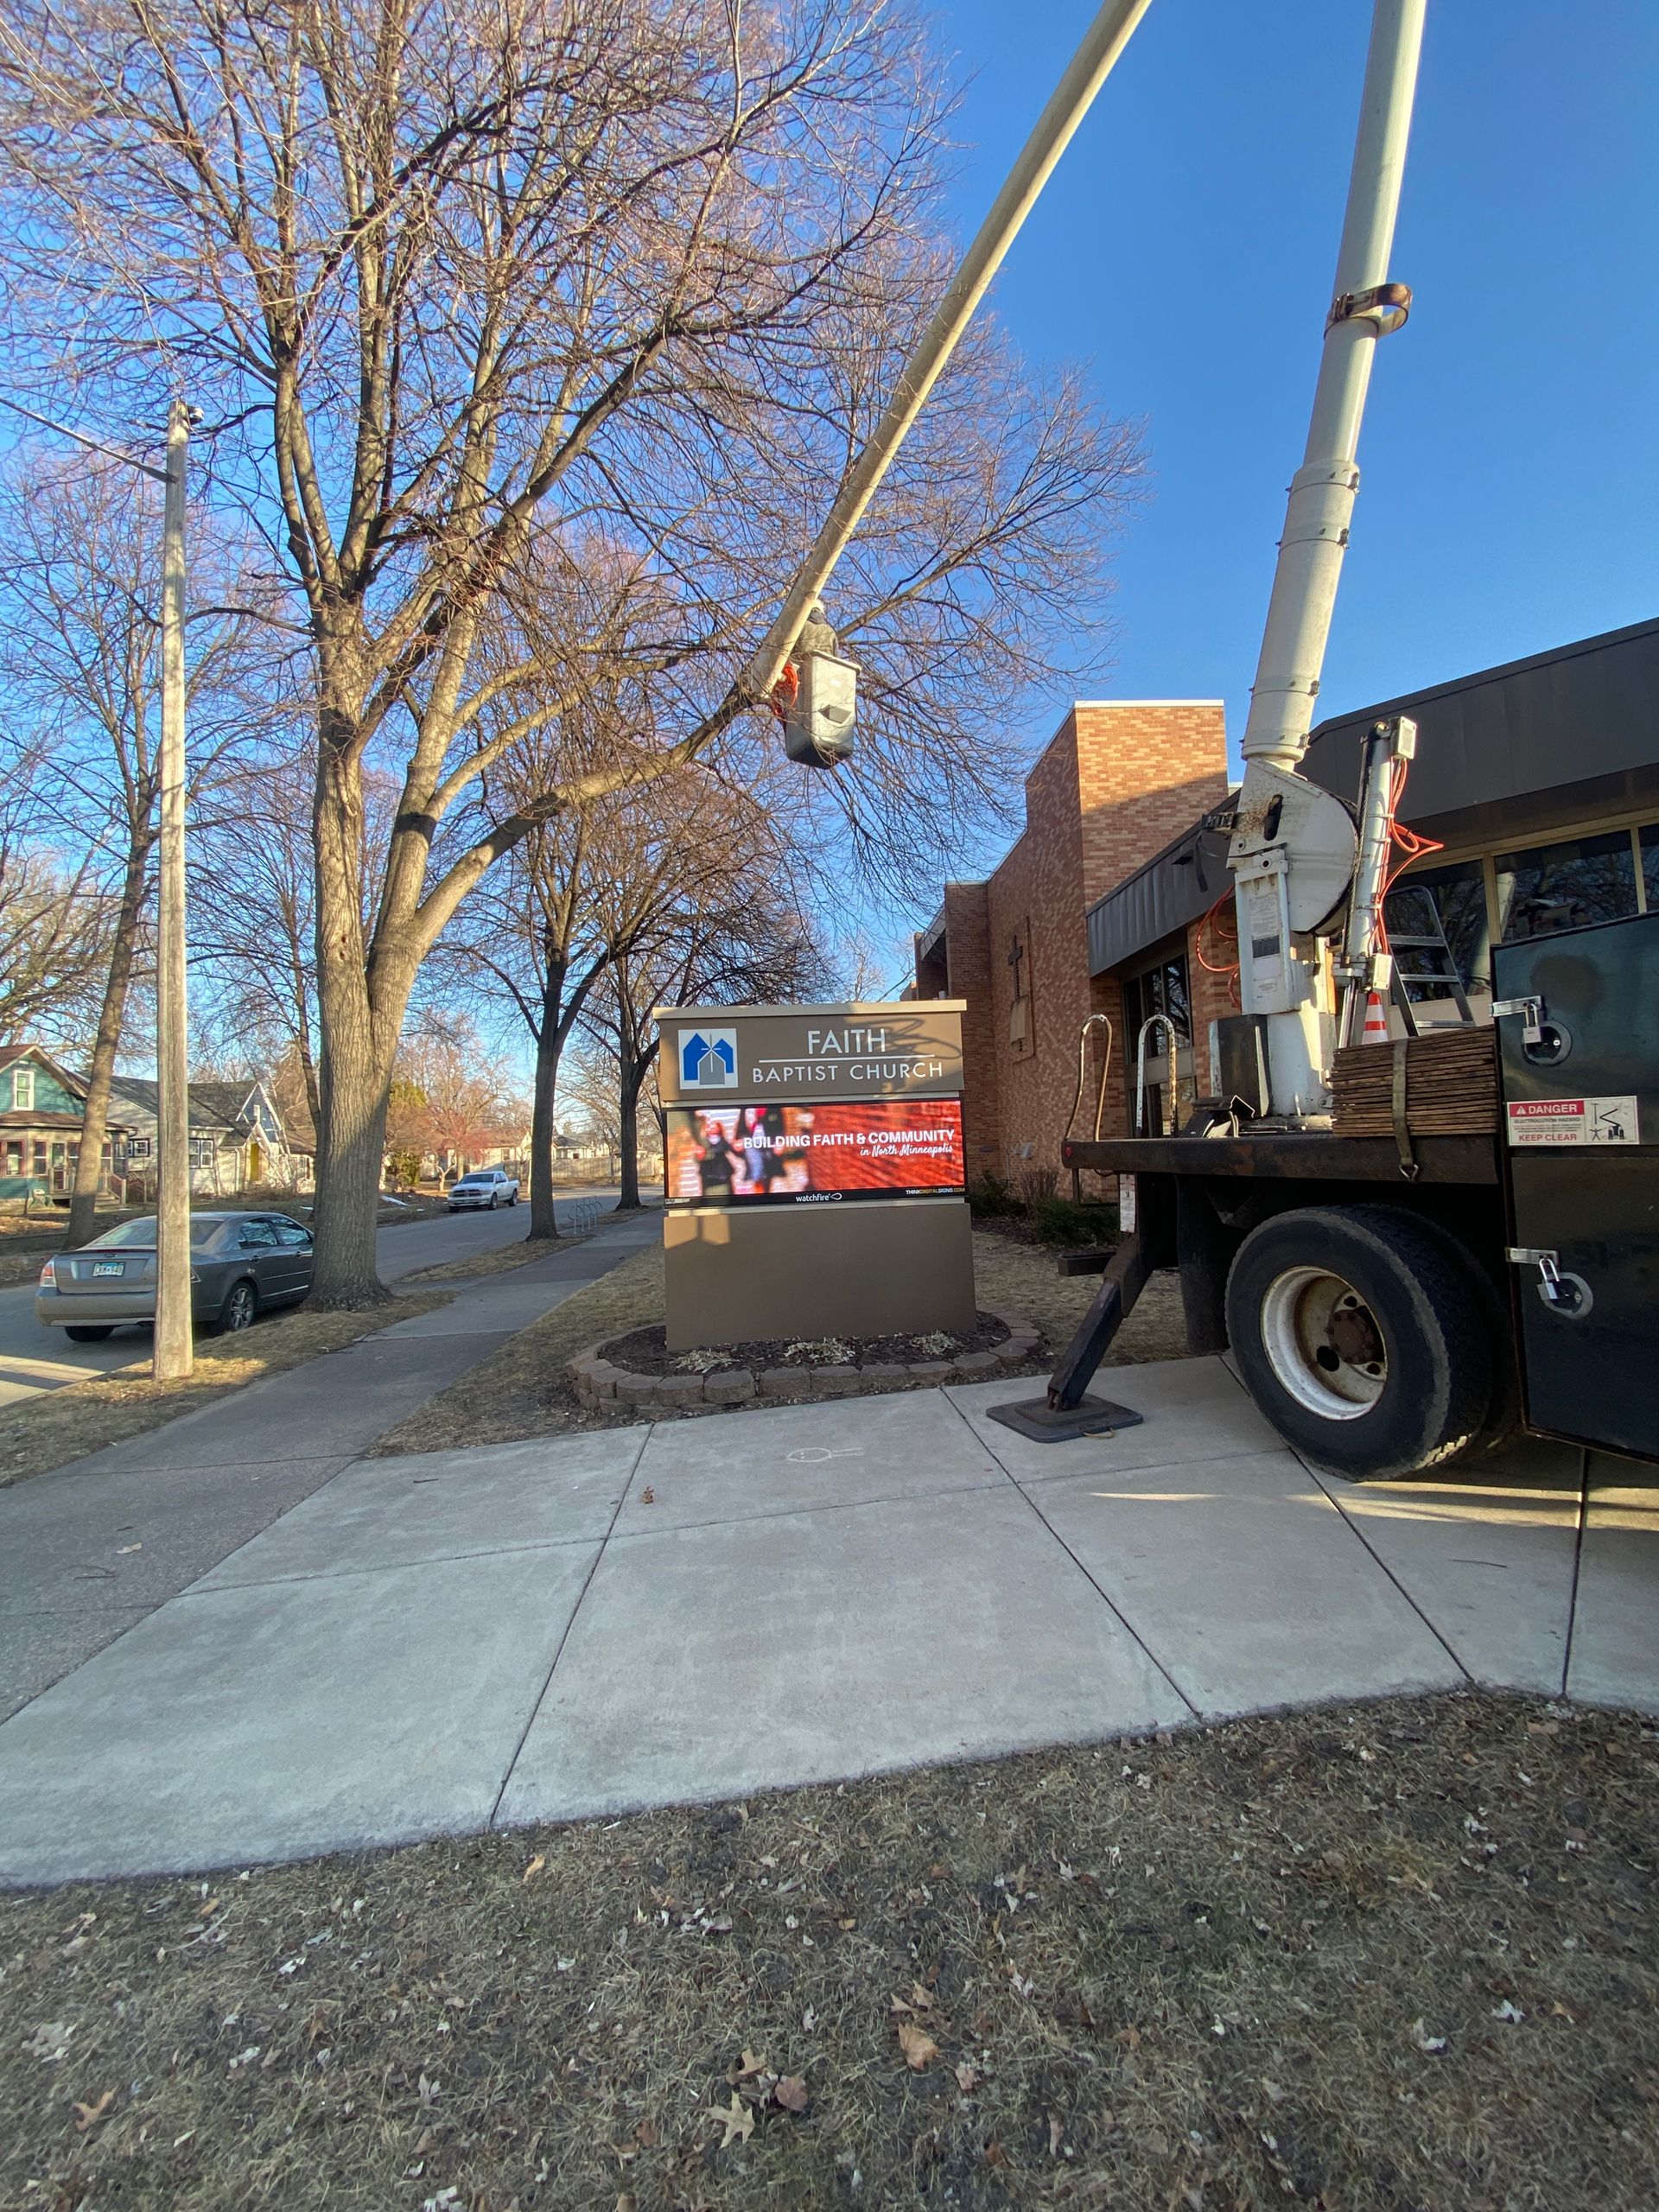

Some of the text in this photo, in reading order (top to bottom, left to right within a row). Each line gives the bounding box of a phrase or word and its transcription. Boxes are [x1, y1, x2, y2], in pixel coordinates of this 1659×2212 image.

[807, 1028, 886, 1054] FAITH
[753, 1062, 943, 1083] BAPTIST CHURCH
[1528, 1103, 1577, 1115] DANGER
[743, 1129, 955, 1148] BUILDING FAITH & COMMUNITY
[861, 1142, 953, 1159] in North Minneapolis
[796, 1193, 830, 1203] watchfire
